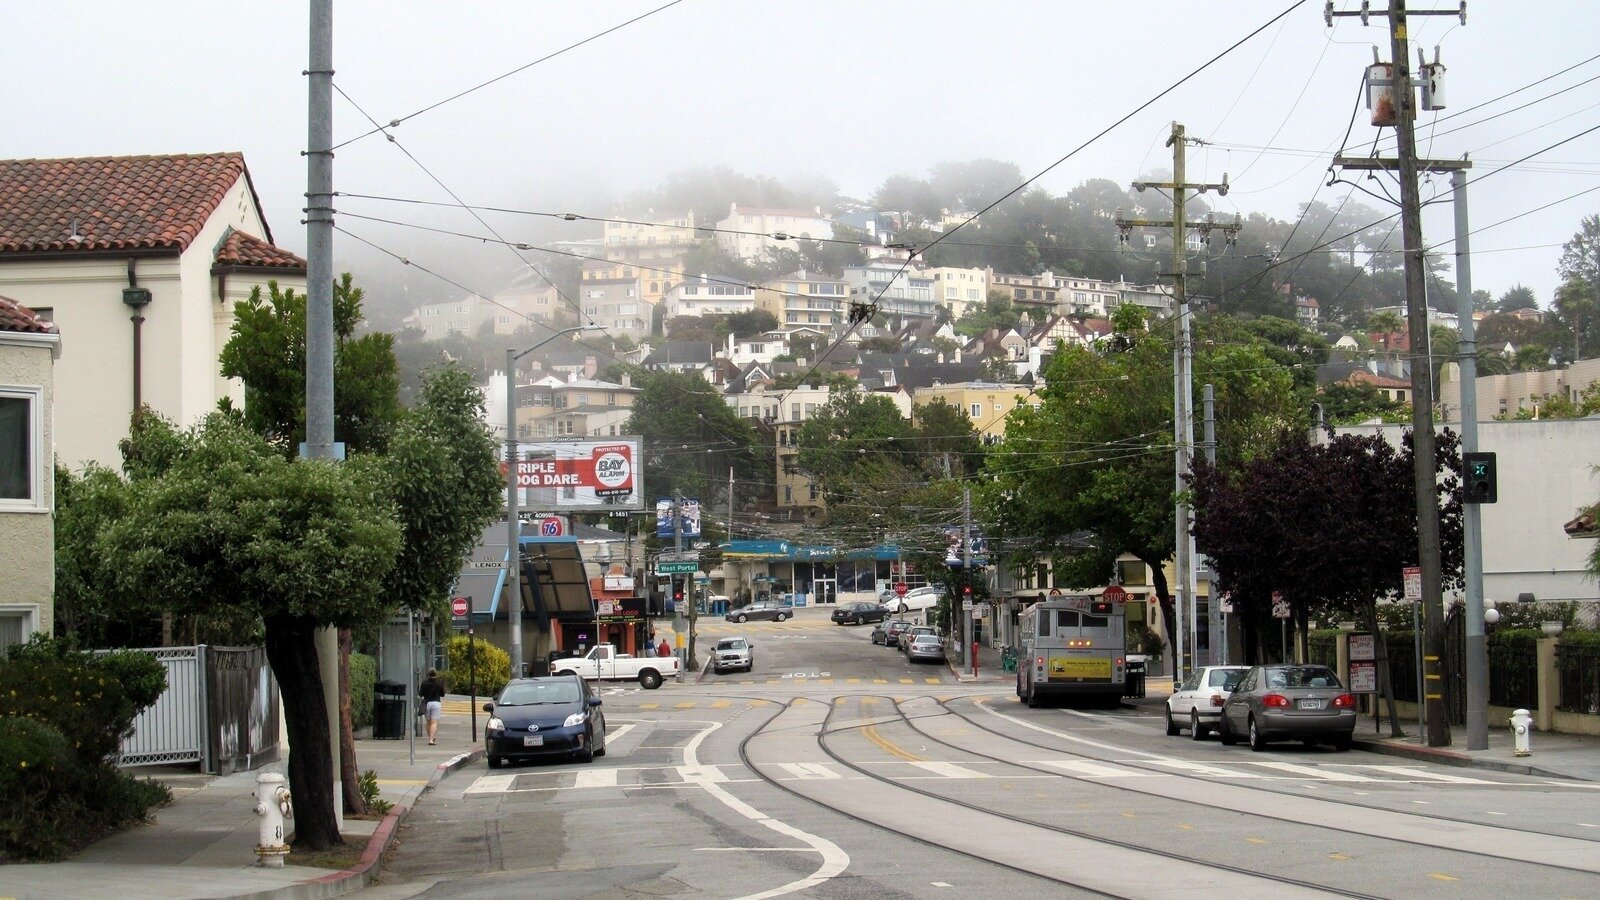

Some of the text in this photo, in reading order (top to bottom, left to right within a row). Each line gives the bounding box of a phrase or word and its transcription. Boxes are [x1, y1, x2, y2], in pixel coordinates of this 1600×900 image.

[518, 462, 555, 473] RIPLE
[598, 459, 625, 471] BAY
[544, 474, 582, 485] DARE.
[543, 521, 558, 536] 76
[1104, 592, 1124, 602] STOP
